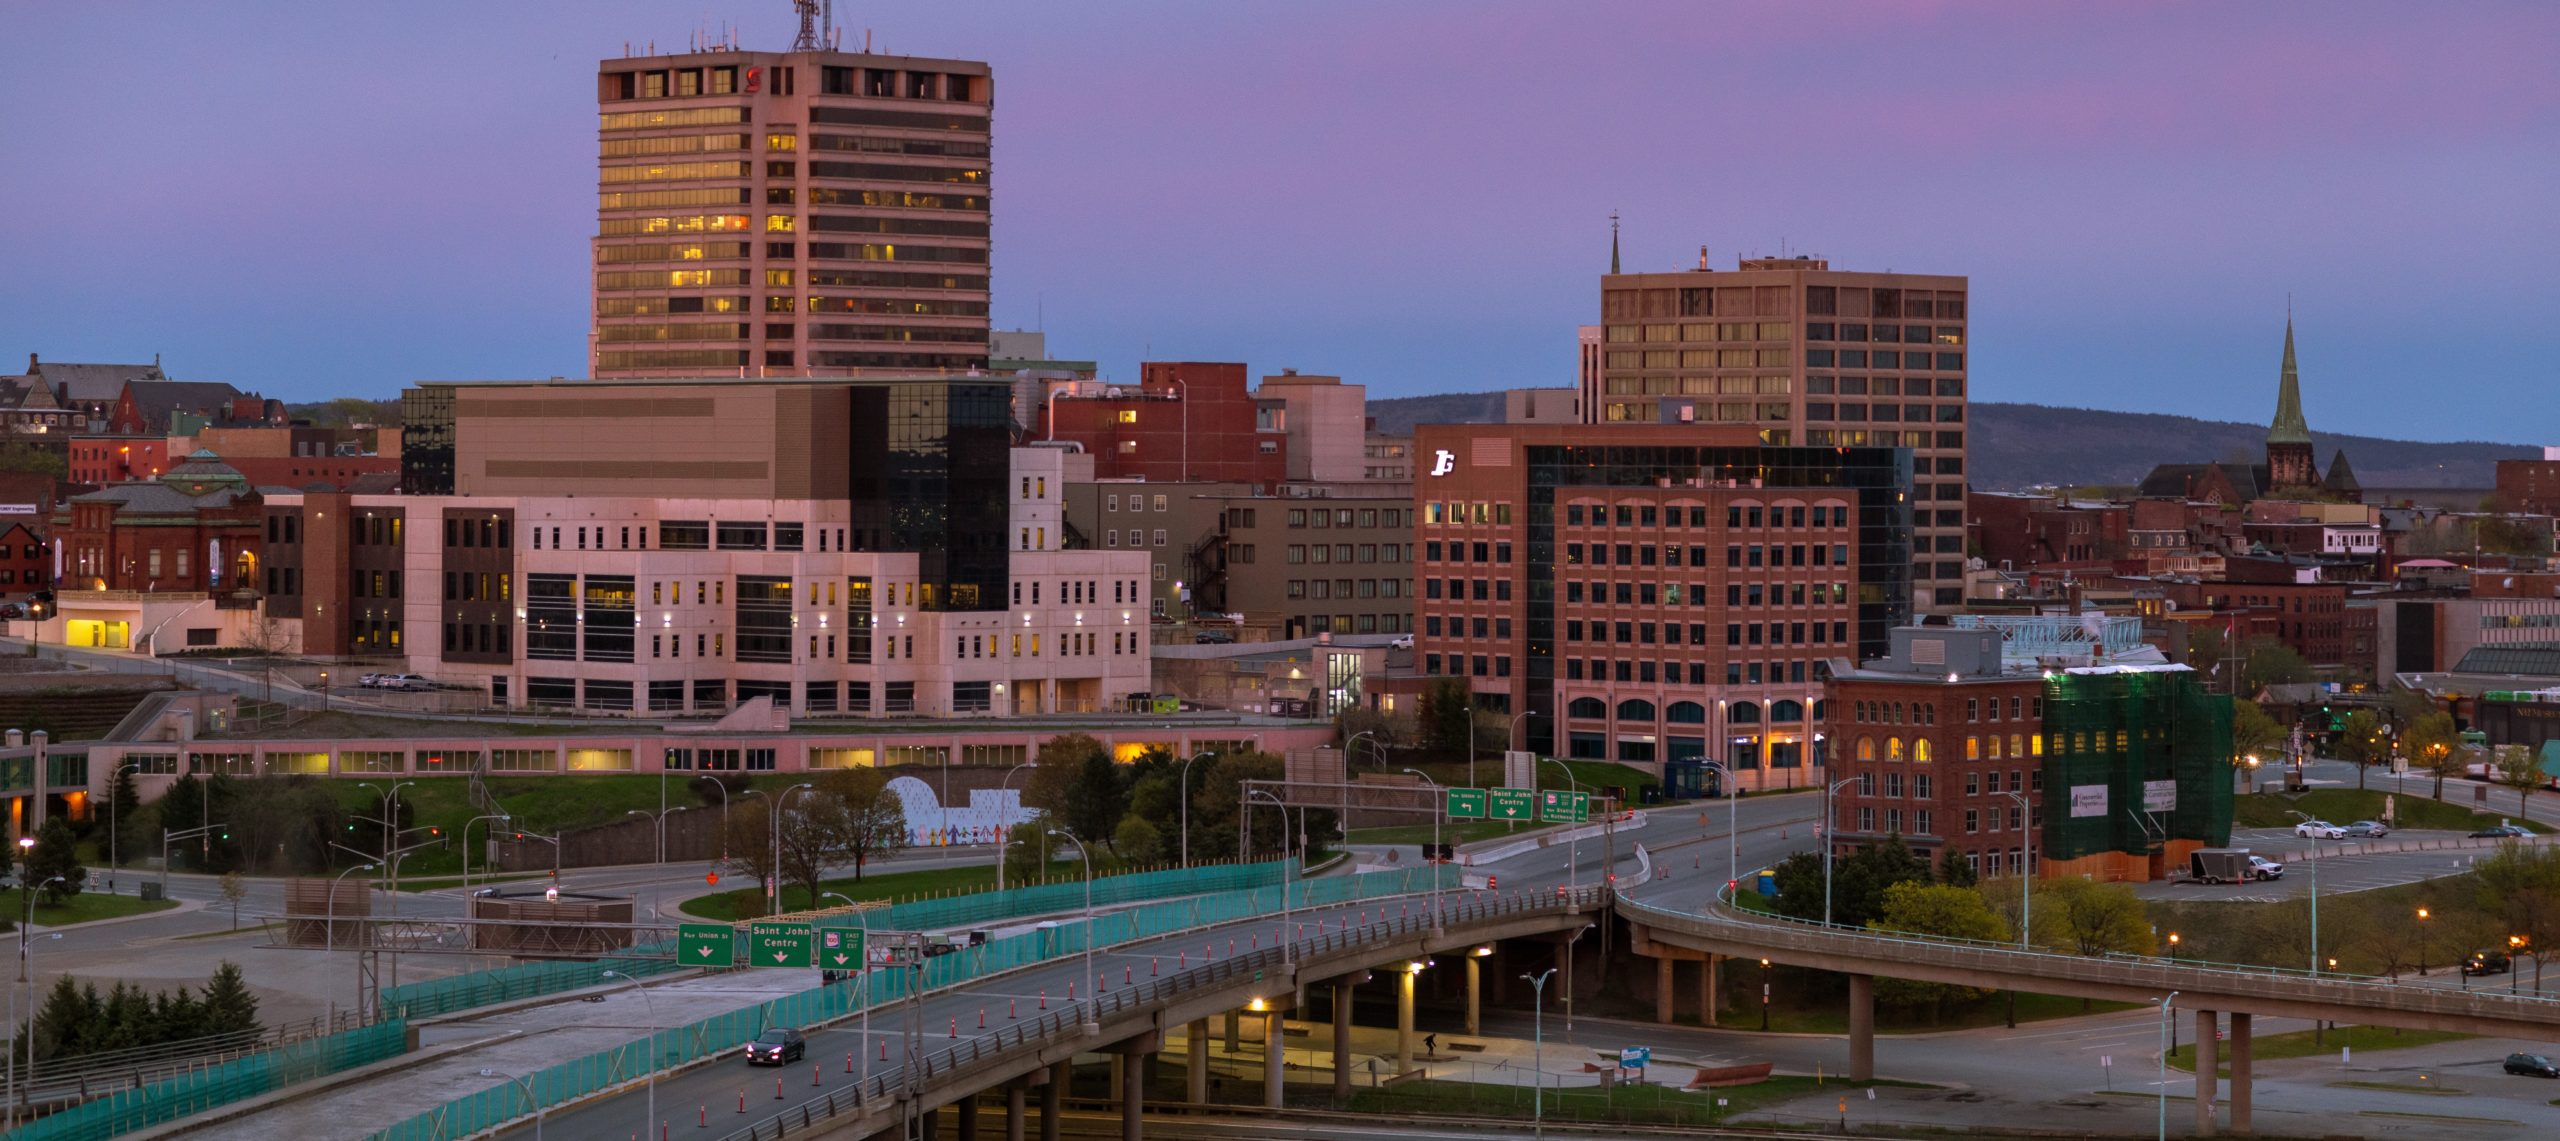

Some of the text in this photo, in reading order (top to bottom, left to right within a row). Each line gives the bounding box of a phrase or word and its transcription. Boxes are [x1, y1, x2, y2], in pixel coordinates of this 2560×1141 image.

[1499, 798, 1524, 806] Centre
[698, 931, 719, 939] Union
[753, 926, 810, 936] Saint John
[764, 938, 798, 948] Centre
